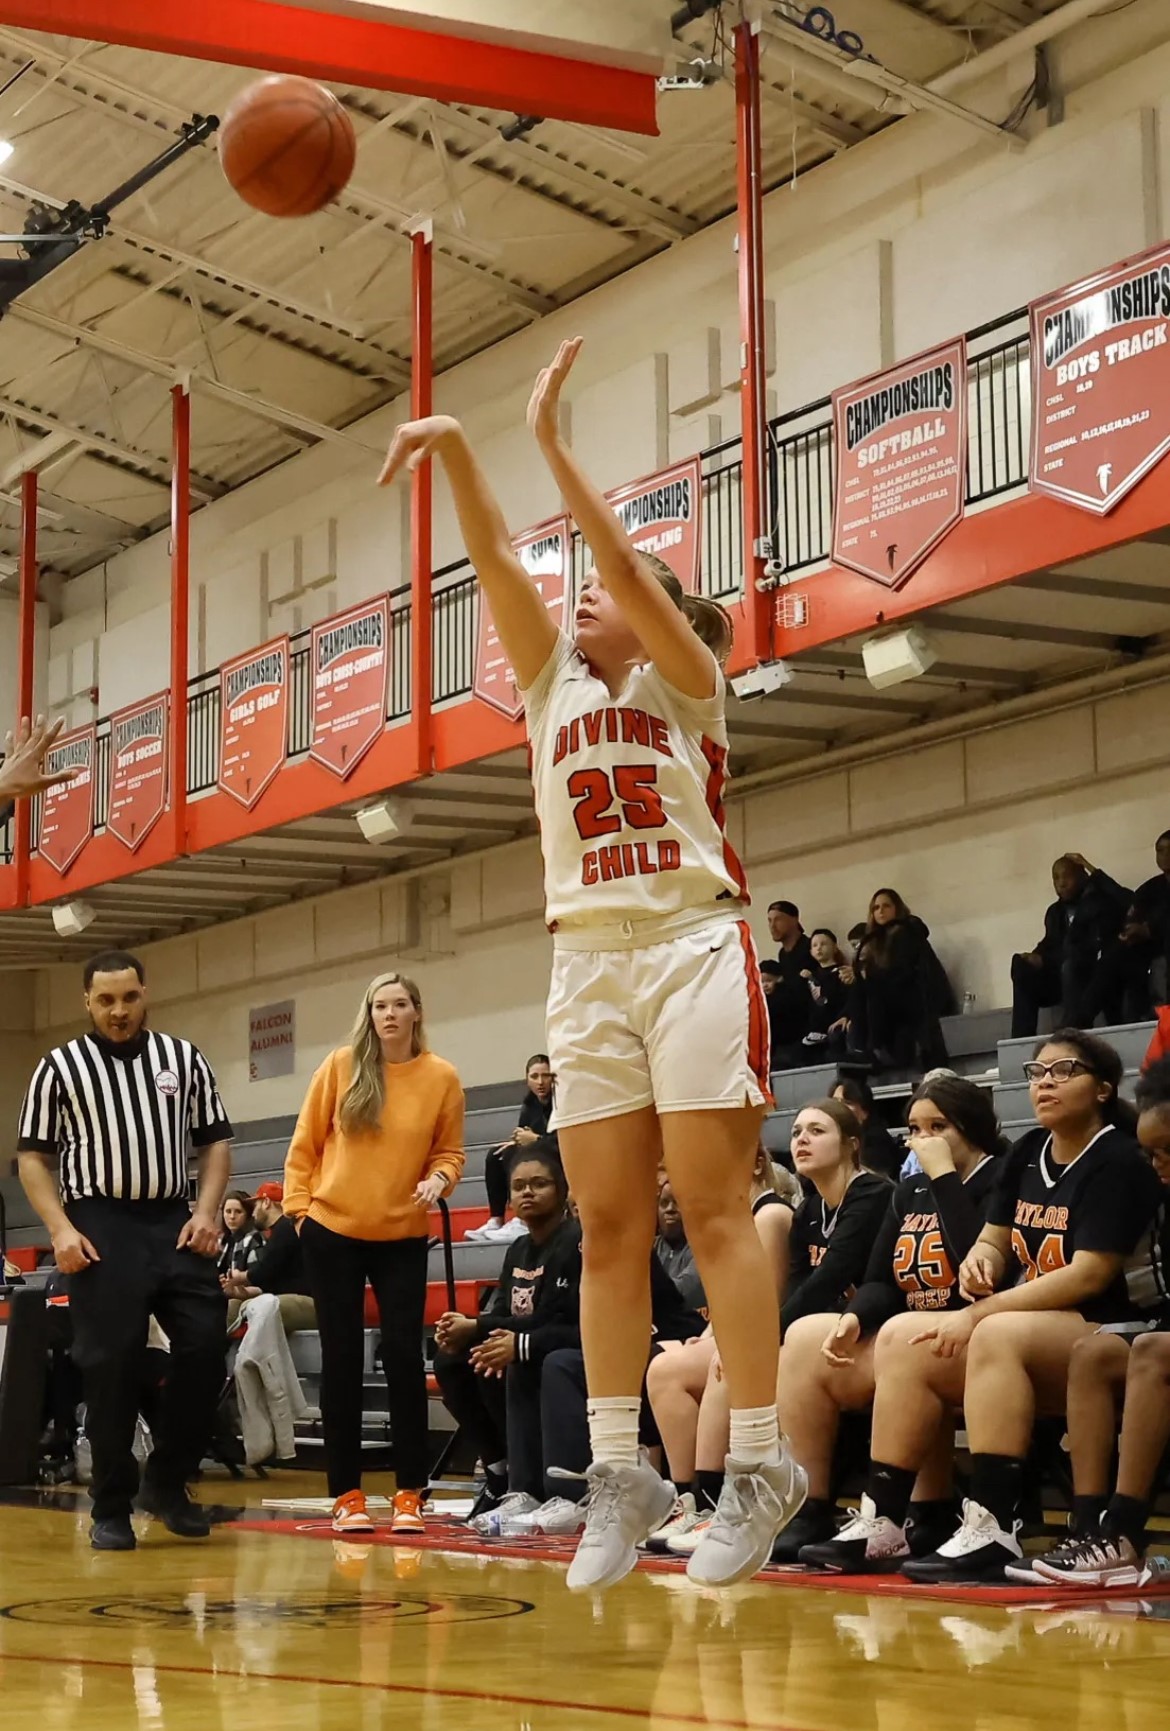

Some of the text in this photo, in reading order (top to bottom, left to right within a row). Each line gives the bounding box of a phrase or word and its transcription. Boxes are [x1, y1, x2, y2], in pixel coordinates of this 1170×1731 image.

[1057, 323, 1167, 386] BOYS TRACK
[847, 362, 952, 450] CHAMPIONSHIPS
[1046, 405, 1076, 424] DISTRICT
[857, 417, 946, 469] SOFTBALL
[1044, 436, 1079, 454] REGIONAL
[1044, 458, 1064, 472] STATE
[318, 611, 382, 671] CHAMPIONSHIPS
[226, 650, 282, 708] CHAMPIONSHIPS
[230, 700, 255, 723] GIRLS
[257, 689, 280, 711] GOLF
[553, 707, 673, 767] DIVINE
[567, 764, 668, 841] 25
[581, 839, 681, 886] CHILD
[250, 1012, 292, 1033] FALCON
[250, 1031, 293, 1054] ALUMNI
[893, 1230, 957, 1291] 25
